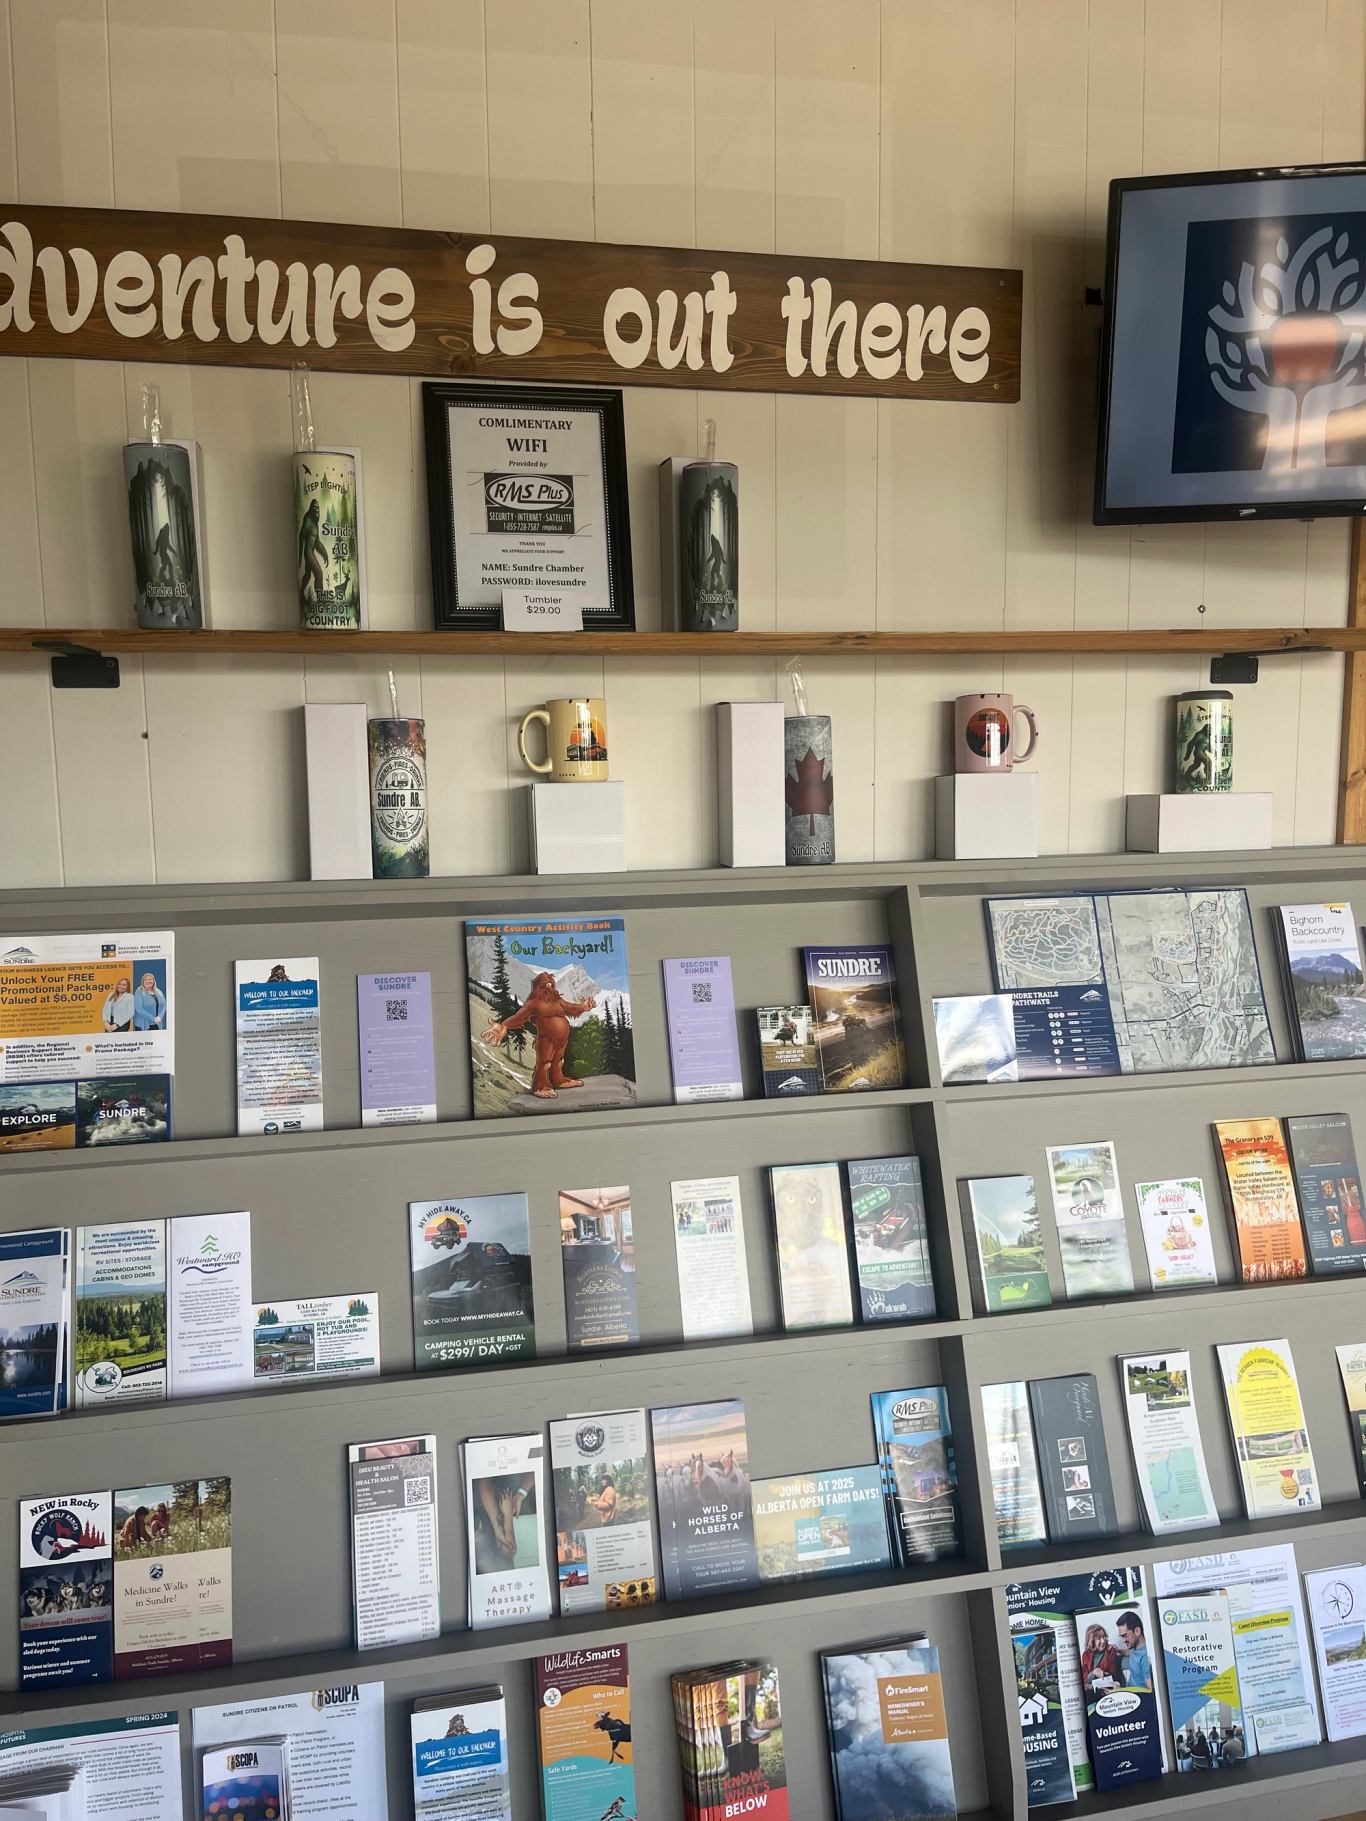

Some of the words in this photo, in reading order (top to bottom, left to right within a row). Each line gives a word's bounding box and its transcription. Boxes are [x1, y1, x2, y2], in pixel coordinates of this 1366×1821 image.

[0, 221, 415, 352] dventure
[467, 244, 543, 357] is
[602, 270, 738, 372] out
[781, 277, 991, 382] there
[479, 417, 572, 430] COMLIMENTARY
[506, 438, 548, 453] WIFI
[494, 481, 533, 502] RMS
[537, 483, 564, 500] Plus
[482, 564, 510, 572] NAME:
[513, 564, 543, 572] Sundre
[546, 564, 584, 573] Chamber
[482, 578, 533, 586] PASSWORD:
[536, 578, 586, 586] ilovesundre
[146, 583, 173, 597] Sundre
[175, 583, 187, 597] AB
[523, 596, 562, 604] Tumbler
[700, 590, 722, 604] Sundre
[527, 606, 560, 615] $29.00
[378, 792, 405, 807] Sundre
[410, 792, 421, 807] AB.
[792, 840, 819, 857] Sundre
[820, 840, 831, 856] AB
[1290, 916, 1323, 925] Bighorn
[1292, 926, 1345, 937] Backcountry
[510, 941, 538, 956] Our
[542, 935, 614, 960] Backyard!
[680, 960, 718, 968] DISCOVER
[818, 958, 882, 978] SUNDRE
[1, 976, 36, 984] Unlock
[41, 975, 64, 983] Your
[67, 973, 94, 981] FREE
[374, 976, 417, 984] DISCOVER
[1, 985, 64, 995] Promotional
[67, 984, 114, 993] Package:
[243, 990, 267, 999] WELCOME
[270, 990, 277, 998] TO
[278, 990, 289, 998] OUR
[1, 996, 37, 1004] Valued
[53, 993, 92, 1003] $6,000
[100, 1107, 146, 1119] SUNDRE
[2, 1114, 57, 1126] EXPLORE
[852, 1162, 911, 1175] WHITEWATER
[861, 1172, 901, 1183] RAFTING
[1069, 1205, 1107, 1216] COYOTE
[176, 1254, 222, 1265] Westward
[96, 1265, 151, 1274] ACCOMMODATIONS
[1, 1286, 42, 1296] SUNDRE
[441, 1316, 460, 1324] TODAY
[460, 1310, 524, 1322] WWW.MYHIDEAWAY.CA
[425, 1340, 462, 1351] CAMPING
[463, 1337, 495, 1347] VEHICLE
[497, 1334, 526, 1343] RENTAL
[896, 1402, 917, 1415] RMS
[919, 1402, 933, 1410] Plus
[778, 1484, 803, 1498] JOIN
[804, 1483, 816, 1494] US
[818, 1481, 830, 1492] AT
[832, 1477, 855, 1490] 2025
[28, 1499, 57, 1517] NEW
[58, 1498, 68, 1508] in
[70, 1497, 100, 1512] Rocky
[756, 1500, 798, 1516] ALBERTA
[799, 1495, 824, 1509] OPEN
[826, 1492, 851, 1506] FARM
[852, 1487, 880, 1502] DAYS!
[702, 1504, 729, 1514] WILD
[688, 1513, 727, 1526] HORSES
[730, 1511, 744, 1521] OF
[694, 1522, 740, 1536] ALBERTA
[124, 1584, 162, 1597] Medicine
[163, 1582, 188, 1592] Walks
[1039, 1586, 1061, 1596] View
[135, 1597, 144, 1606] in
[146, 1594, 177, 1606] Sundre!
[487, 1593, 535, 1606] Massage
[485, 1605, 532, 1618] Therapy
[1178, 1611, 1208, 1621] FASD
[1238, 1622, 1252, 1630] Court
[1271, 1616, 1289, 1624] Program
[1184, 1633, 1208, 1642] Rural
[1172, 1642, 1223, 1654] Restorative
[544, 1651, 586, 1672] Wildlife
[586, 1648, 621, 1661] Smarts
[1183, 1654, 1215, 1663] Justice
[1182, 1663, 1218, 1675] Program
[1099, 1701, 1123, 1710] Mountain
[125, 1715, 150, 1724] SPRING
[151, 1712, 168, 1720] 2024
[1096, 1720, 1146, 1739] Volunteer
[420, 1749, 446, 1760] WELCOME
[458, 1745, 470, 1754] OUR
[235, 1752, 258, 1768] SCOPA
[725, 1794, 767, 1818] BELOW
